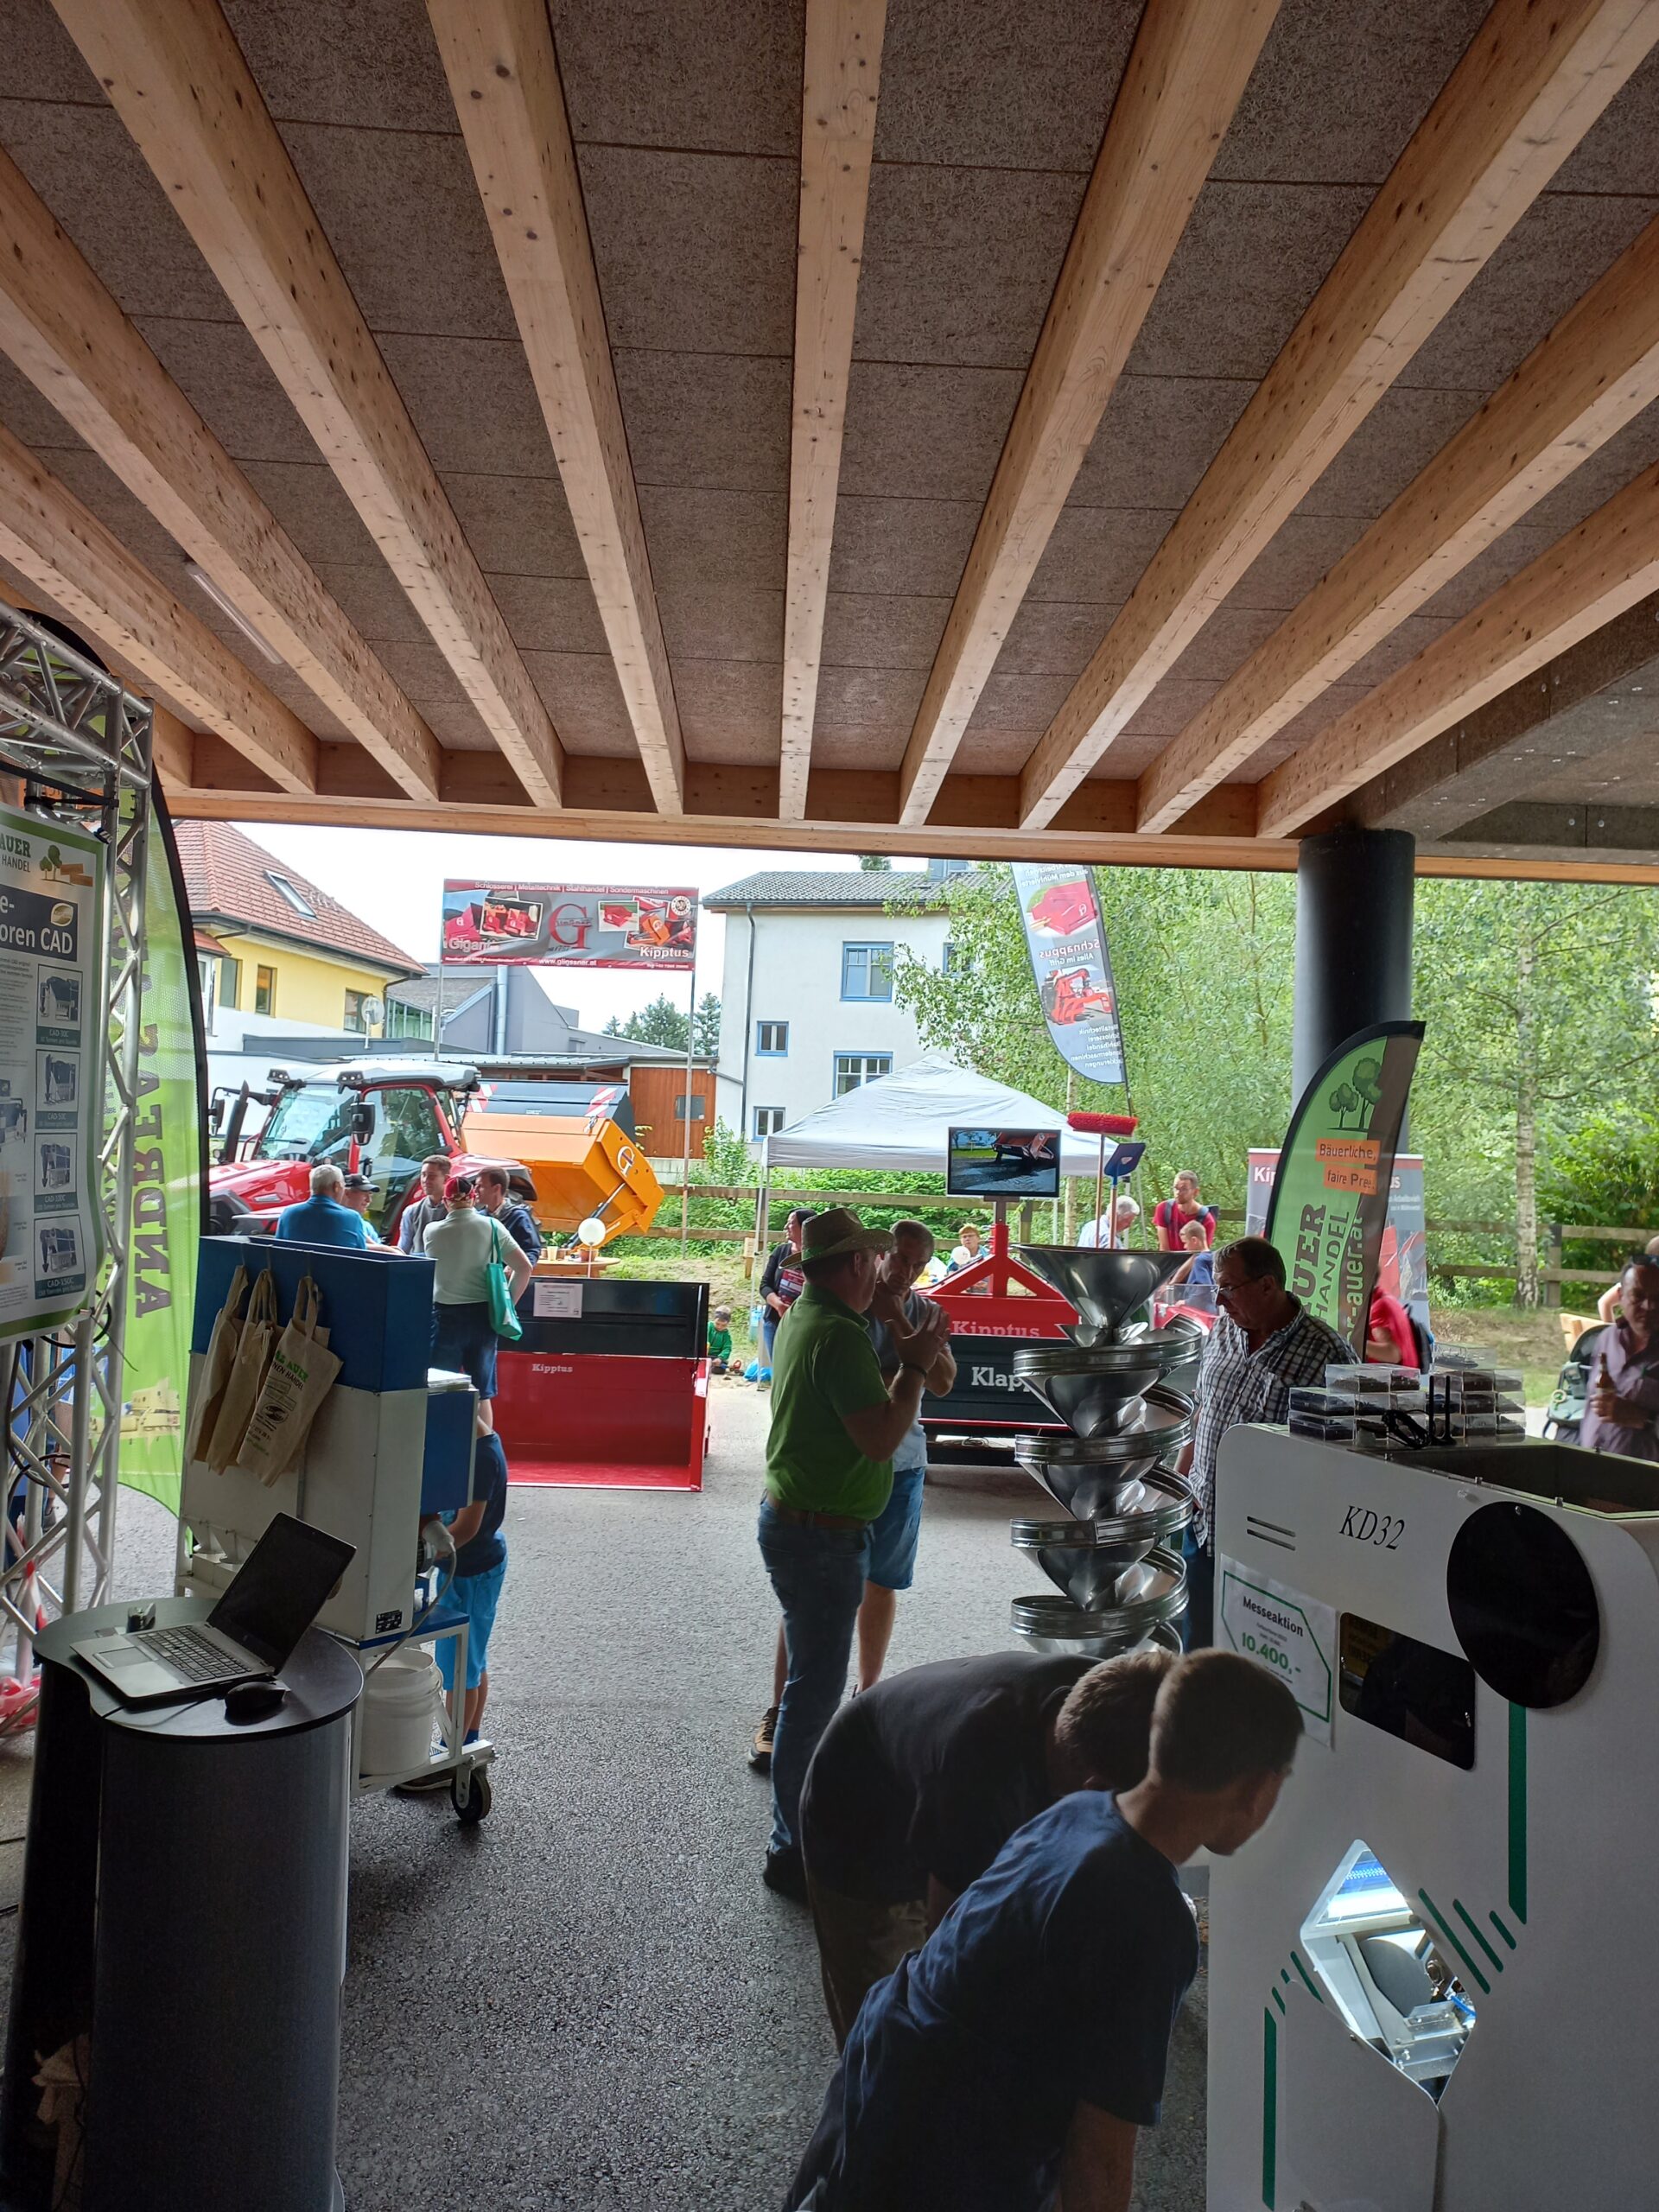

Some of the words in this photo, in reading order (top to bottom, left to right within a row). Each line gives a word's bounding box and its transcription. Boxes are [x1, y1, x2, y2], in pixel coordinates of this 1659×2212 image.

[2, 854, 31, 873] HANDEL
[610, 887, 669, 895] Sondermaschinen
[41, 927, 73, 955] CAD
[639, 946, 690, 959] Kipptus
[1319, 1143, 1376, 1161] Bäuerliche,
[531, 1363, 574, 1374] Kipptus
[1339, 1505, 1405, 1551] KD32
[1243, 1596, 1304, 1637] Messeaktion
